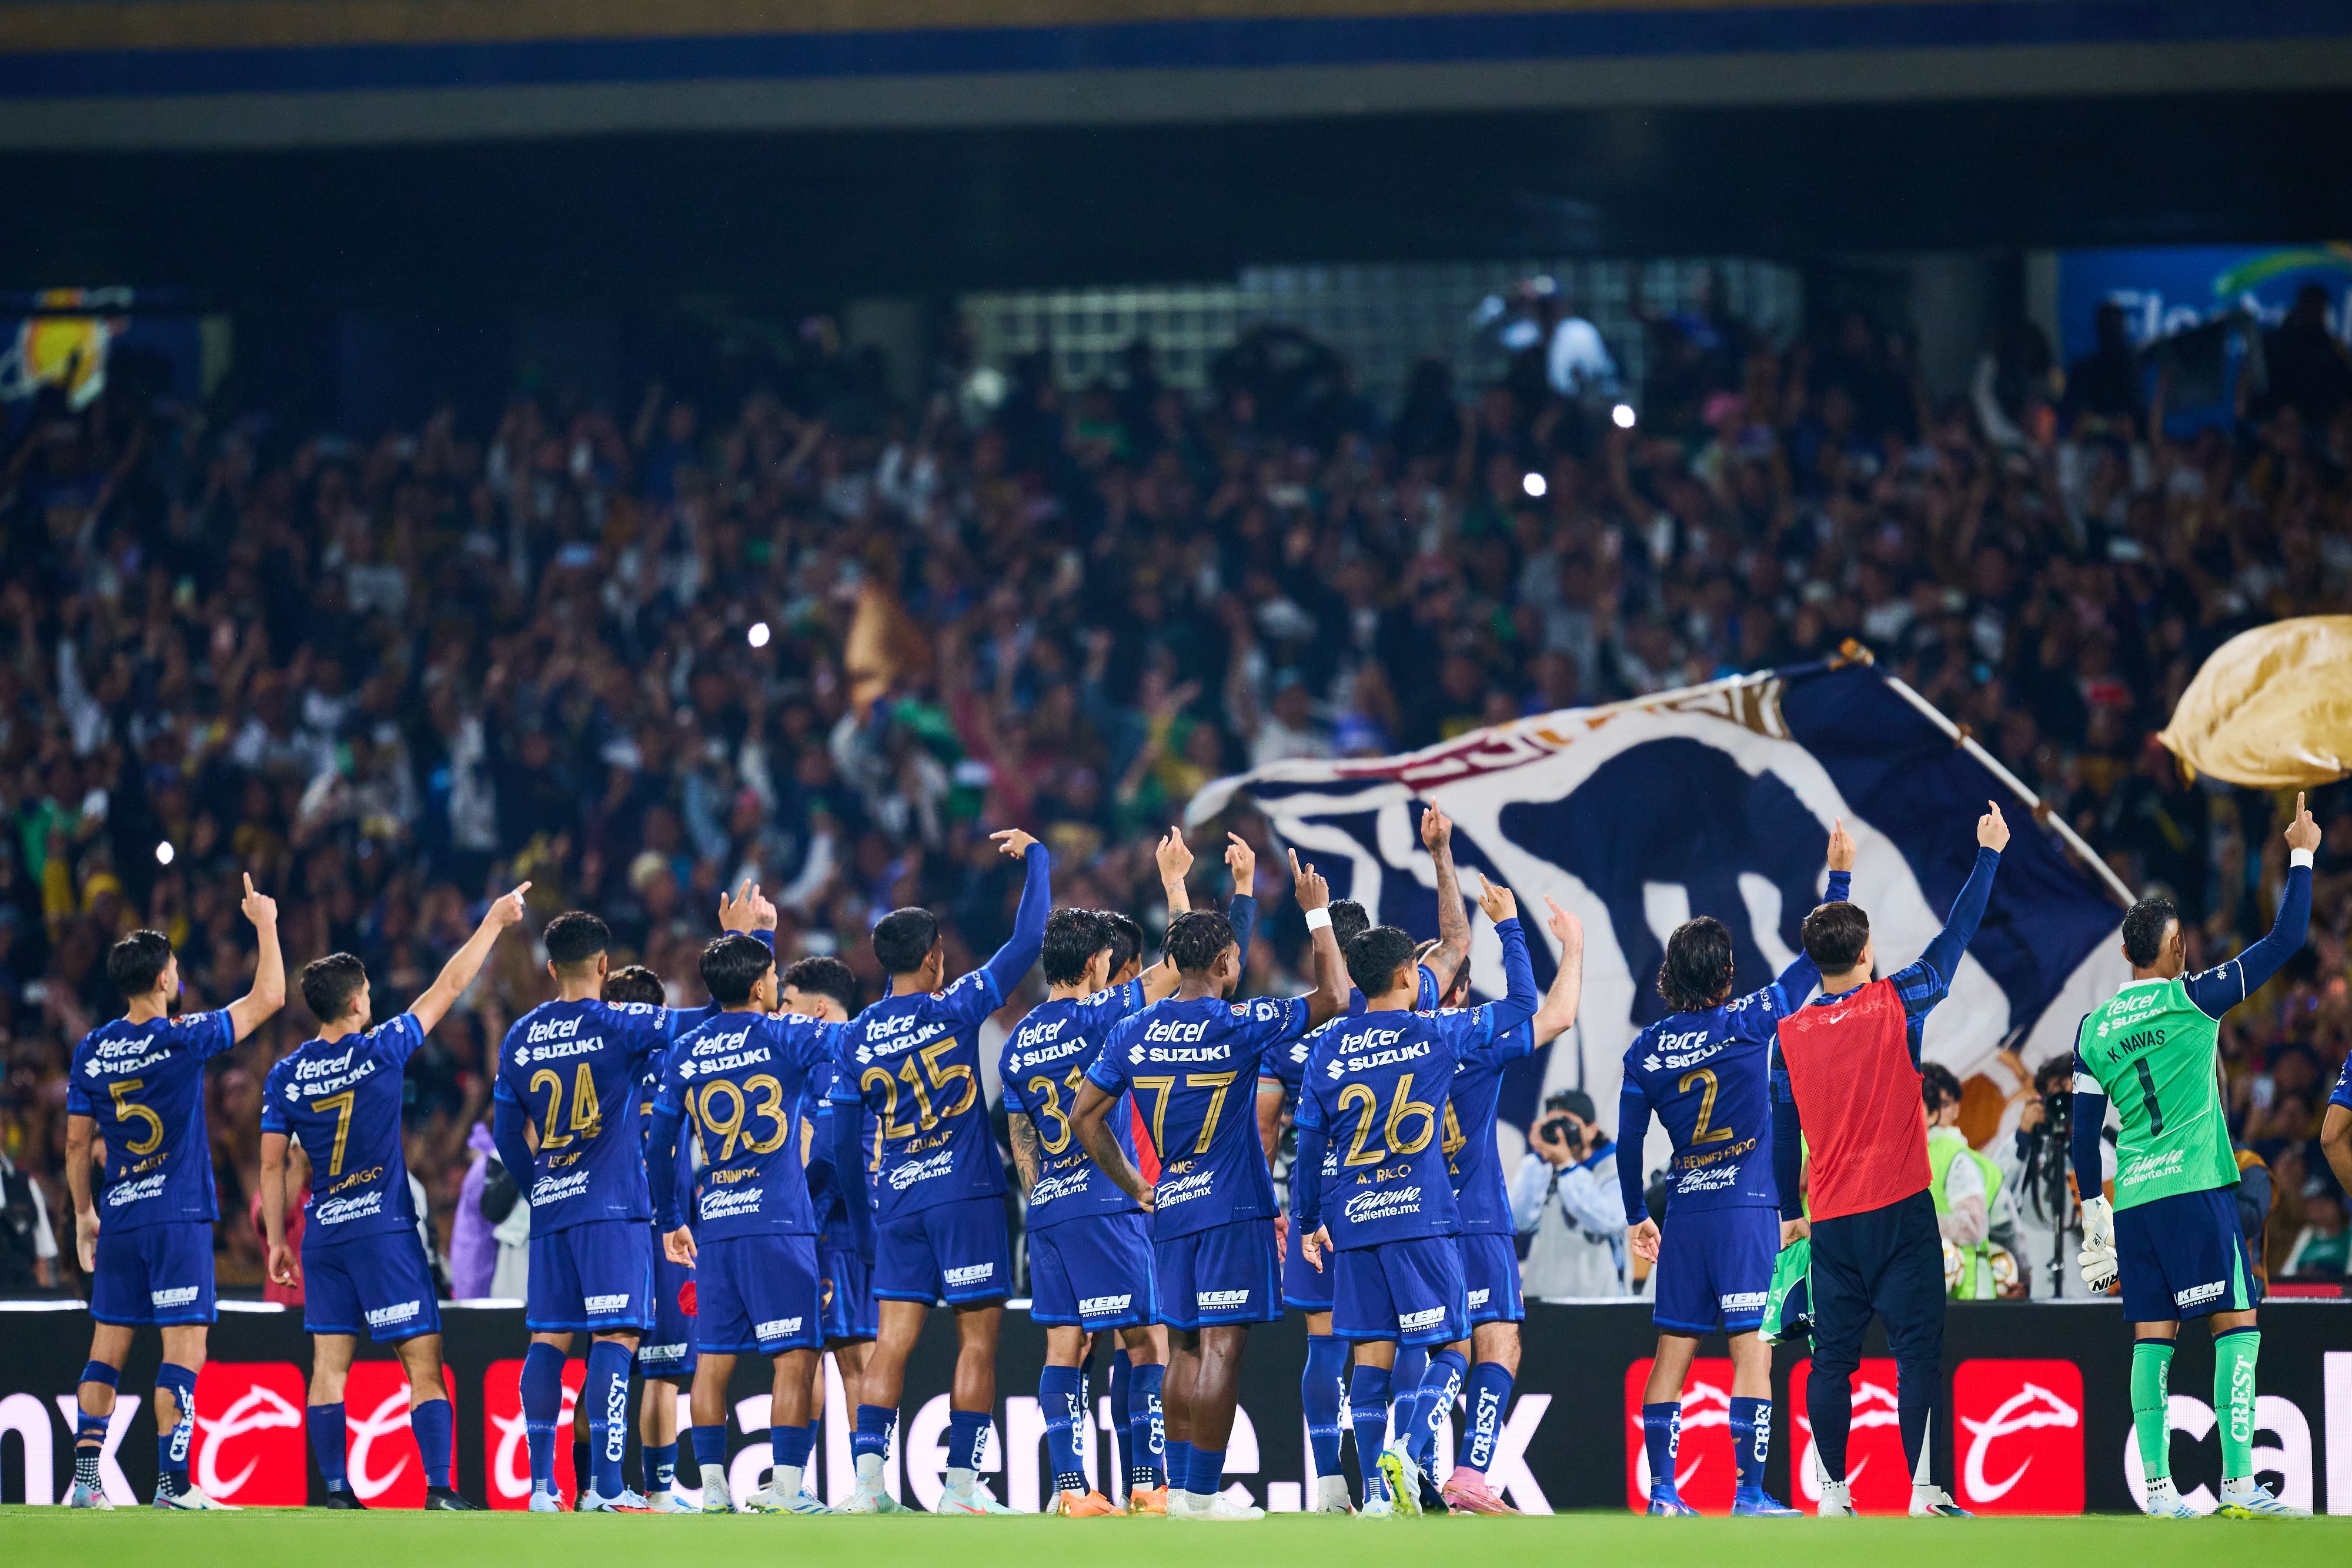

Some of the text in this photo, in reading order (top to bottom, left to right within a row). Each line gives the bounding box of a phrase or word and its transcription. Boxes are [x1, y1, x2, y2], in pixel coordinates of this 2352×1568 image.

[2106, 989, 2160, 1017] telcel
[526, 1014, 584, 1044] telcel
[866, 1005, 922, 1042] telce
[1144, 1019, 1210, 1042] telcel
[2112, 1005, 2167, 1030] SUZUKI
[691, 1025, 752, 1057] telcel
[873, 1022, 946, 1057] SUZUKI
[1017, 1018, 1067, 1049] telcel
[532, 1037, 604, 1061] SUZUKI
[699, 1047, 771, 1074] SUZUKI
[1023, 1036, 1088, 1066] SUZUKI
[1149, 1044, 1231, 1062] SUZUKI
[1348, 1040, 1431, 1072] SUZUKI
[295, 1047, 354, 1081] telcel
[303, 1059, 376, 1096] SUZUKI
[860, 1035, 978, 1139] 215
[2133, 1057, 2164, 1137] 1
[109, 1078, 164, 1155] 5
[530, 1062, 603, 1149] 24
[684, 1074, 789, 1165] 193
[1132, 1070, 1238, 1159] 77
[1338, 1072, 1436, 1167] 26
[1679, 1068, 1733, 1146] 2
[310, 1089, 355, 1176] 7
[1357, 1164, 1411, 1185] A. RICO
[2123, 1165, 2183, 1186] caliente.mx
[532, 1185, 587, 1207] caliente.mx
[700, 1187, 763, 1215] Caliente
[1344, 1186, 1422, 1216] Caliente
[321, 1205, 381, 1226] caliente.mx
[702, 1203, 760, 1221] caliente.mx
[1351, 1202, 1420, 1223] caliente.mx
[947, 1262, 994, 1280] KEM
[951, 1277, 987, 1288] AUTOPARTES
[152, 1286, 199, 1301] KEM
[585, 1294, 630, 1309] KEM
[1079, 1293, 1131, 1310] KEM
[1198, 1289, 1250, 1303] KEM
[1721, 1292, 1768, 1306] KEM
[2177, 1281, 2226, 1302] KEM
[2182, 1296, 2217, 1309] AUTOPARTES
[370, 1300, 420, 1320] KEM
[1083, 1309, 1121, 1318] AUTOPARTES
[1399, 1306, 1446, 1325] KEM
[756, 1317, 802, 1336] KEM
[1402, 1322, 1439, 1333] AUTOPARTES
[1427, 1368, 1463, 1432] CRE
[2229, 1354, 2253, 1442] CREST
[606, 1373, 628, 1462] CREST
[1147, 1394, 1165, 1455] CRE
[1470, 1387, 1499, 1467] CREST
